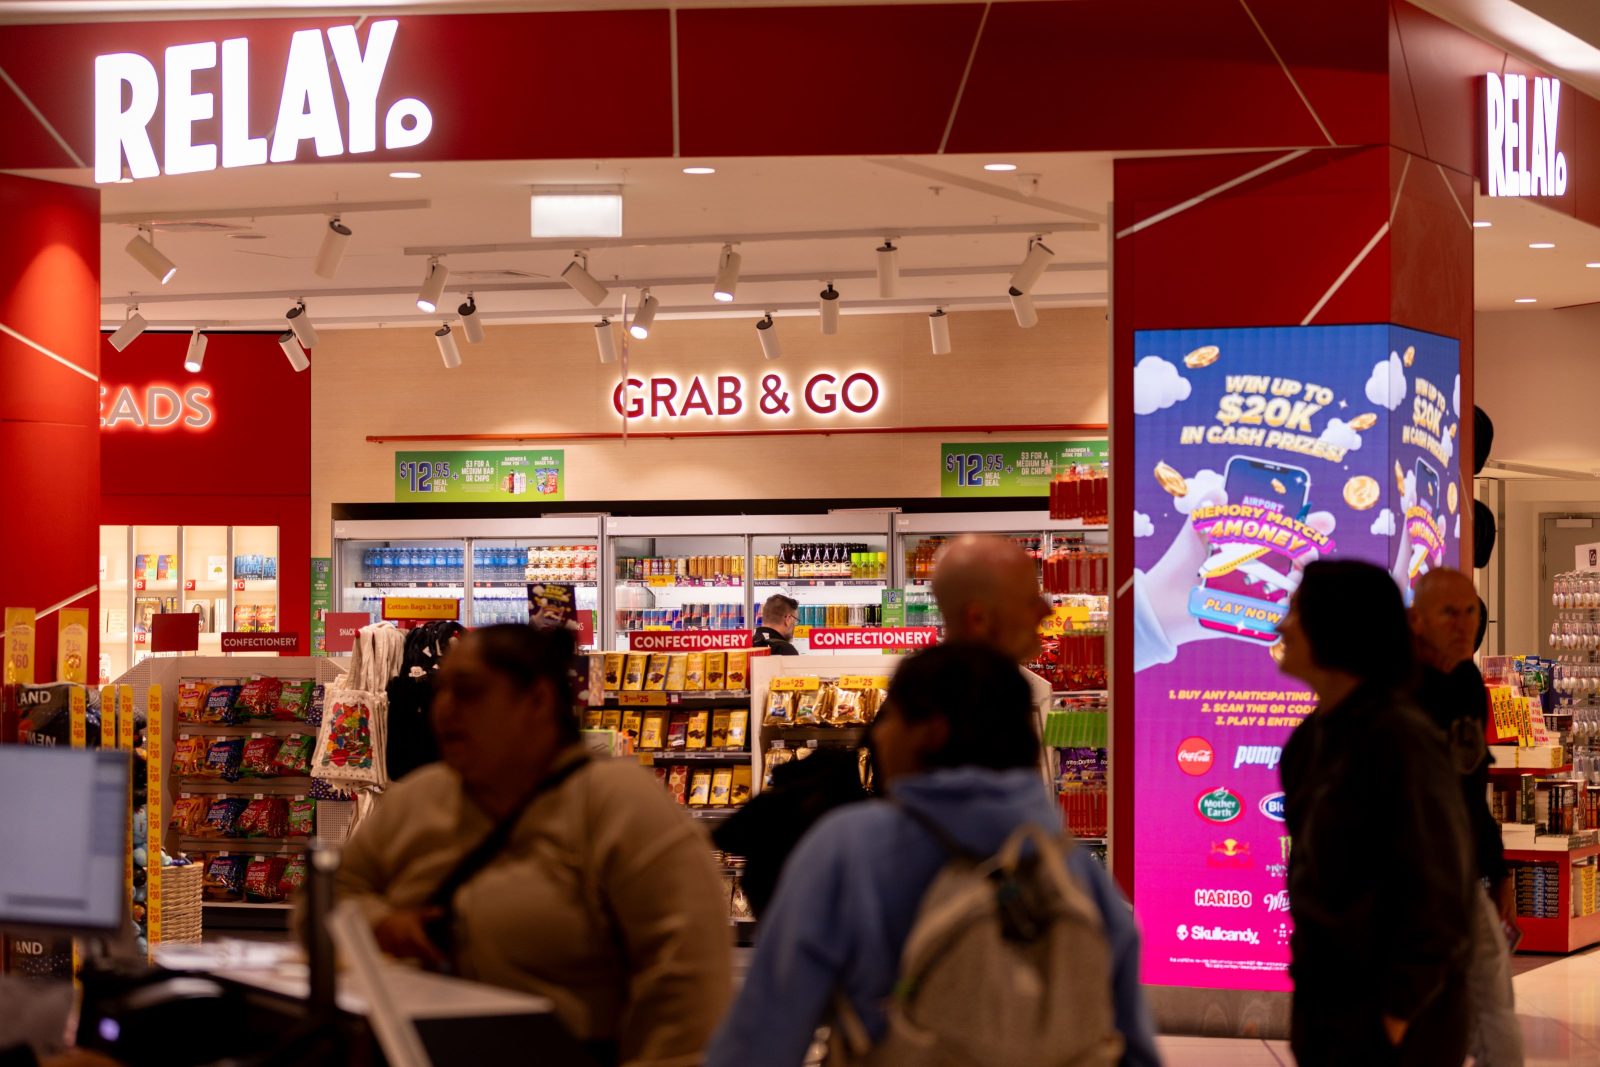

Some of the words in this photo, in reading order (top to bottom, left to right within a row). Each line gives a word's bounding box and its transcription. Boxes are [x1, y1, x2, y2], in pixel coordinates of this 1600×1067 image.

[613, 376, 742, 418] GRAB
[760, 374, 790, 414] &
[805, 373, 879, 414] GO
[1226, 375, 1271, 394] WIN
[1271, 377, 1302, 397] UP
[1304, 382, 1334, 406] TO
[1216, 393, 1322, 433] $20K
[1412, 395, 1442, 438] $20K
[1180, 426, 1205, 445] IN
[1206, 425, 1266, 447] CASH
[1242, 496, 1285, 513] AIRPORT
[1191, 504, 1265, 521] MEMORY
[1265, 511, 1329, 546] MATCH
[1210, 520, 1307, 551] 4MONEY
[234, 581, 245, 589] 10
[1205, 598, 1243, 615] PLAY
[1245, 607, 1281, 624] NOW
[223, 638, 297, 647] CONFECTIONERY
[634, 634, 748, 648] CONFECTIONERY
[814, 631, 932, 645] CONFECTIONERY
[791, 678, 805, 687] $25
[860, 677, 873, 686] $25
[1169, 690, 1176, 699] 1.
[1178, 690, 1200, 699] BUY
[1202, 690, 1226, 699] ANY
[1227, 690, 1311, 700] PARTICIPATING
[1201, 703, 1211, 712] 2.
[1213, 703, 1244, 713] SCAN
[1246, 703, 1268, 713] THE
[1226, 716, 1256, 726] PLAY
[1257, 716, 1265, 725] &
[1204, 799, 1236, 808] Mother
[1207, 808, 1232, 817] Earth
[1195, 889, 1252, 907] HARIBO
